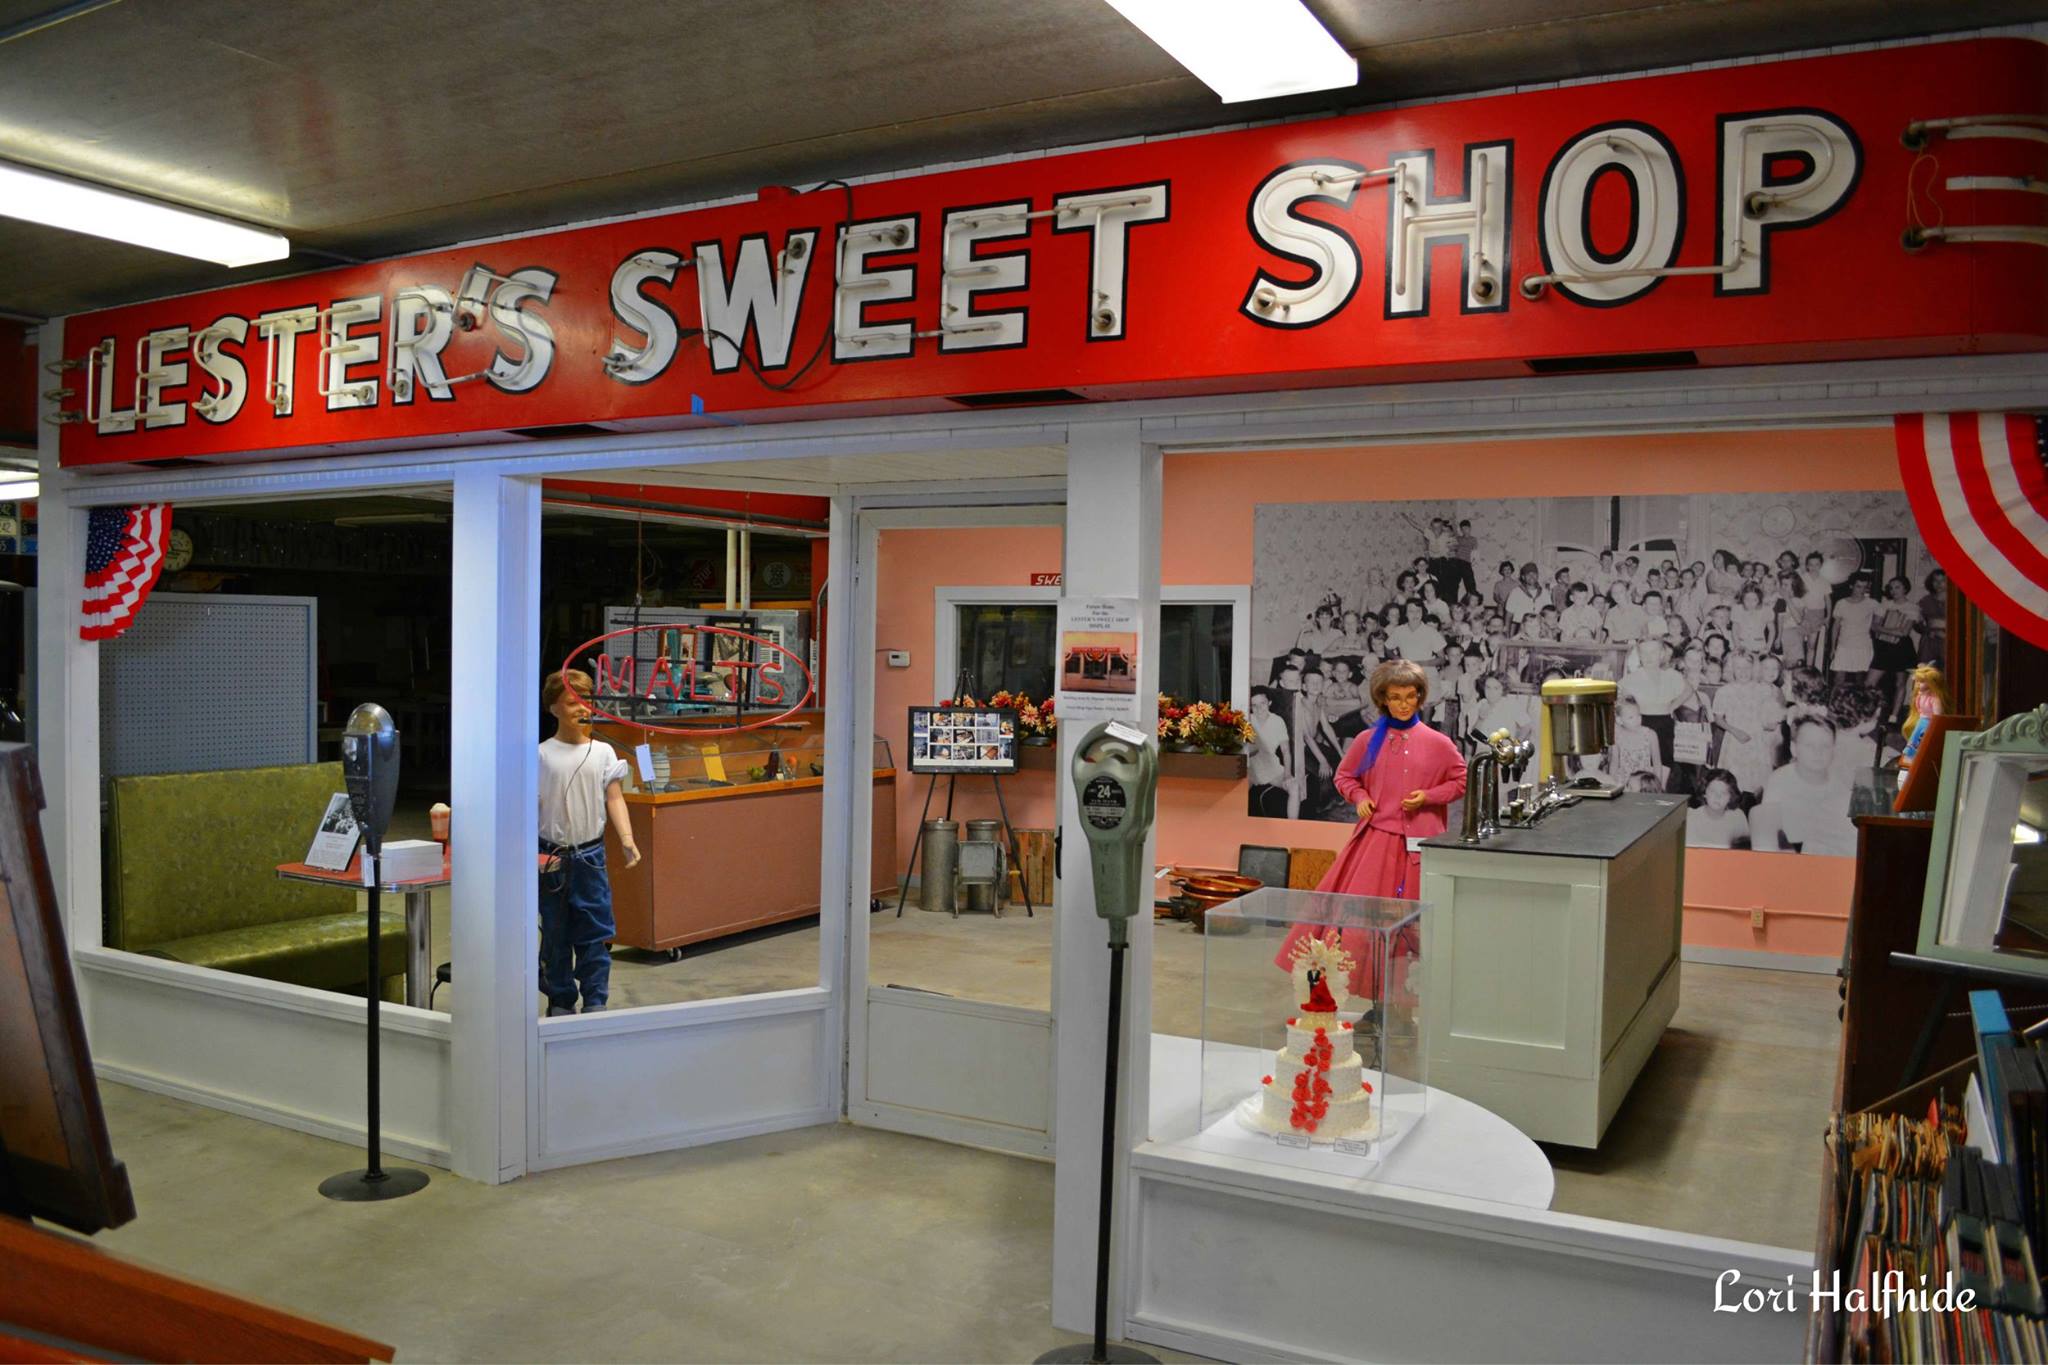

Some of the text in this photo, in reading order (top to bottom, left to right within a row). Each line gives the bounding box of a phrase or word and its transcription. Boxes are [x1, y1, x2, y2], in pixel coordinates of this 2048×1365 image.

[91, 106, 1864, 435] LESTER'S SWEET SHOP
[597, 653, 784, 704] MALTS
[1097, 784, 1111, 799] 24
